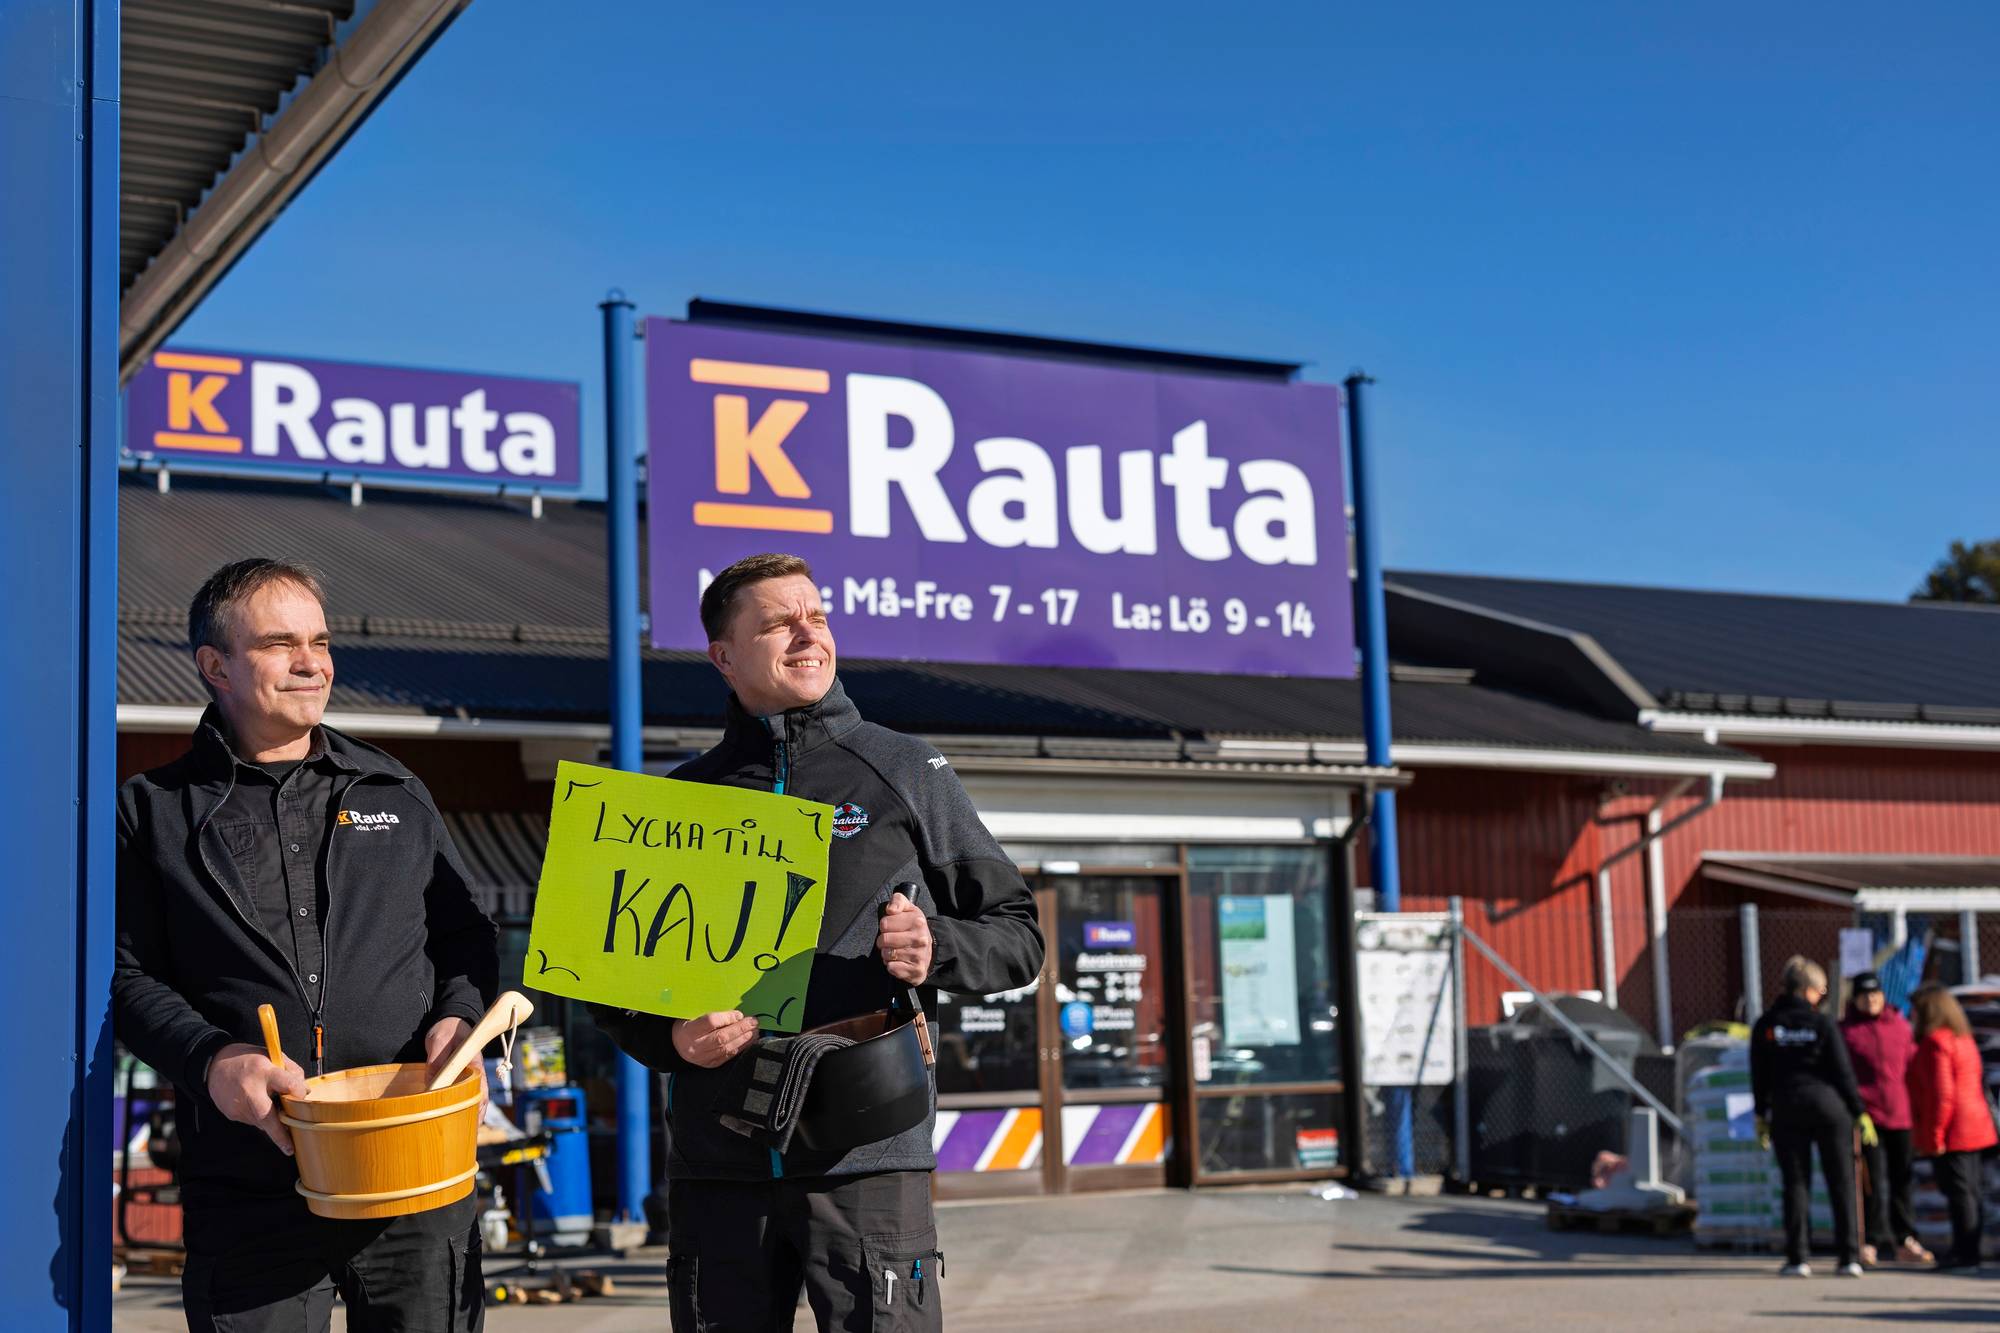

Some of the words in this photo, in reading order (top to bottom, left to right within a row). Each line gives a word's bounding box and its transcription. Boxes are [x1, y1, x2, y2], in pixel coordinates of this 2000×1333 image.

[251, 361, 556, 477] Rauta
[846, 373, 1318, 566] Rauta
[843, 576, 973, 621] Må-Fre
[988, 584, 1012, 623] 7
[1040, 588, 1079, 626] 17
[1111, 592, 1163, 631] La:
[1169, 595, 1211, 633] Lö
[1223, 598, 1249, 636] 9
[1275, 601, 1315, 639] 14
[349, 810, 400, 824] Rauta
[593, 801, 704, 851] LYCKA
[603, 869, 818, 972] KAJ!
